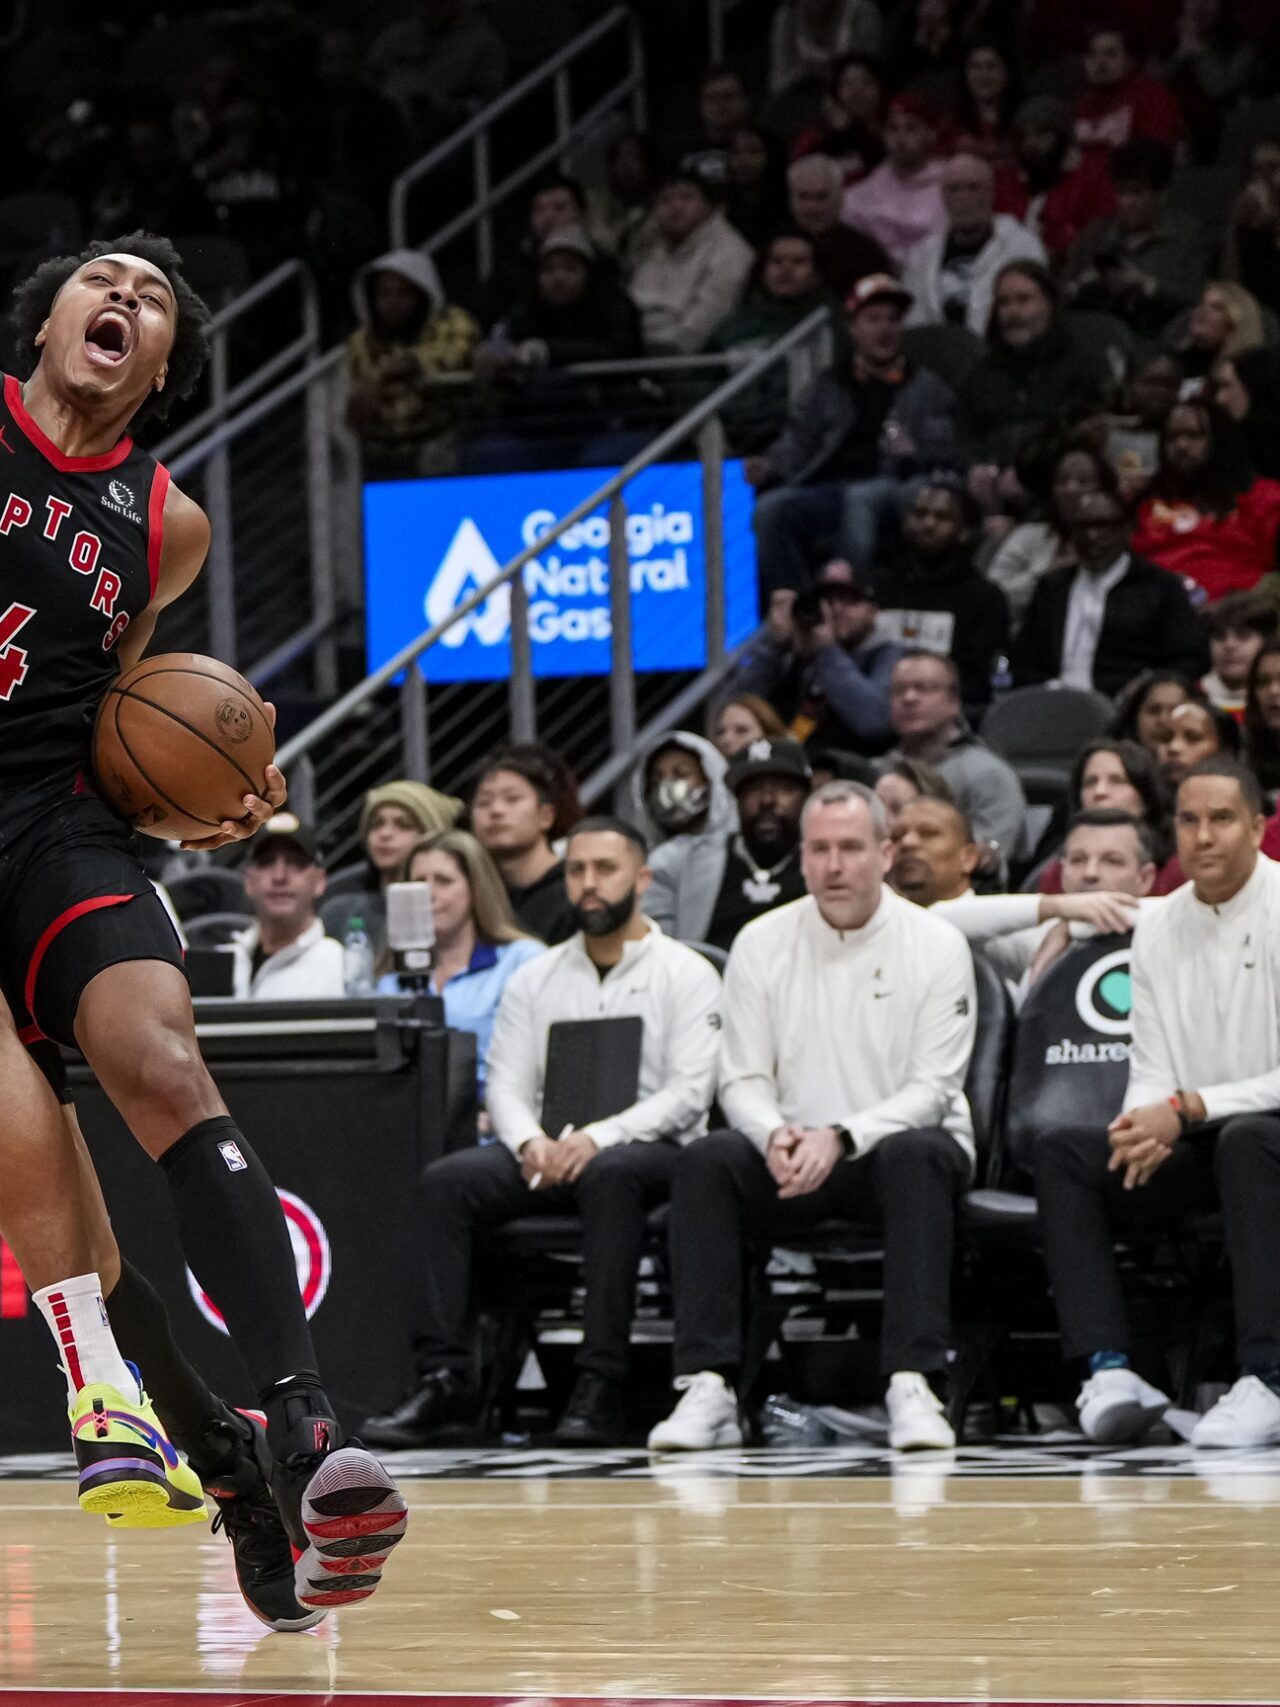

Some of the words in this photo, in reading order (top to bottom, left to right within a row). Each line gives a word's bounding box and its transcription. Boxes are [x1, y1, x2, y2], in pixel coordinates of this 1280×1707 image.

[101, 495, 121, 513] Sun
[123, 507, 142, 524] Life
[521, 502, 693, 557] Geogia
[522, 547, 691, 598] Natral
[1045, 1038, 1131, 1065] share
